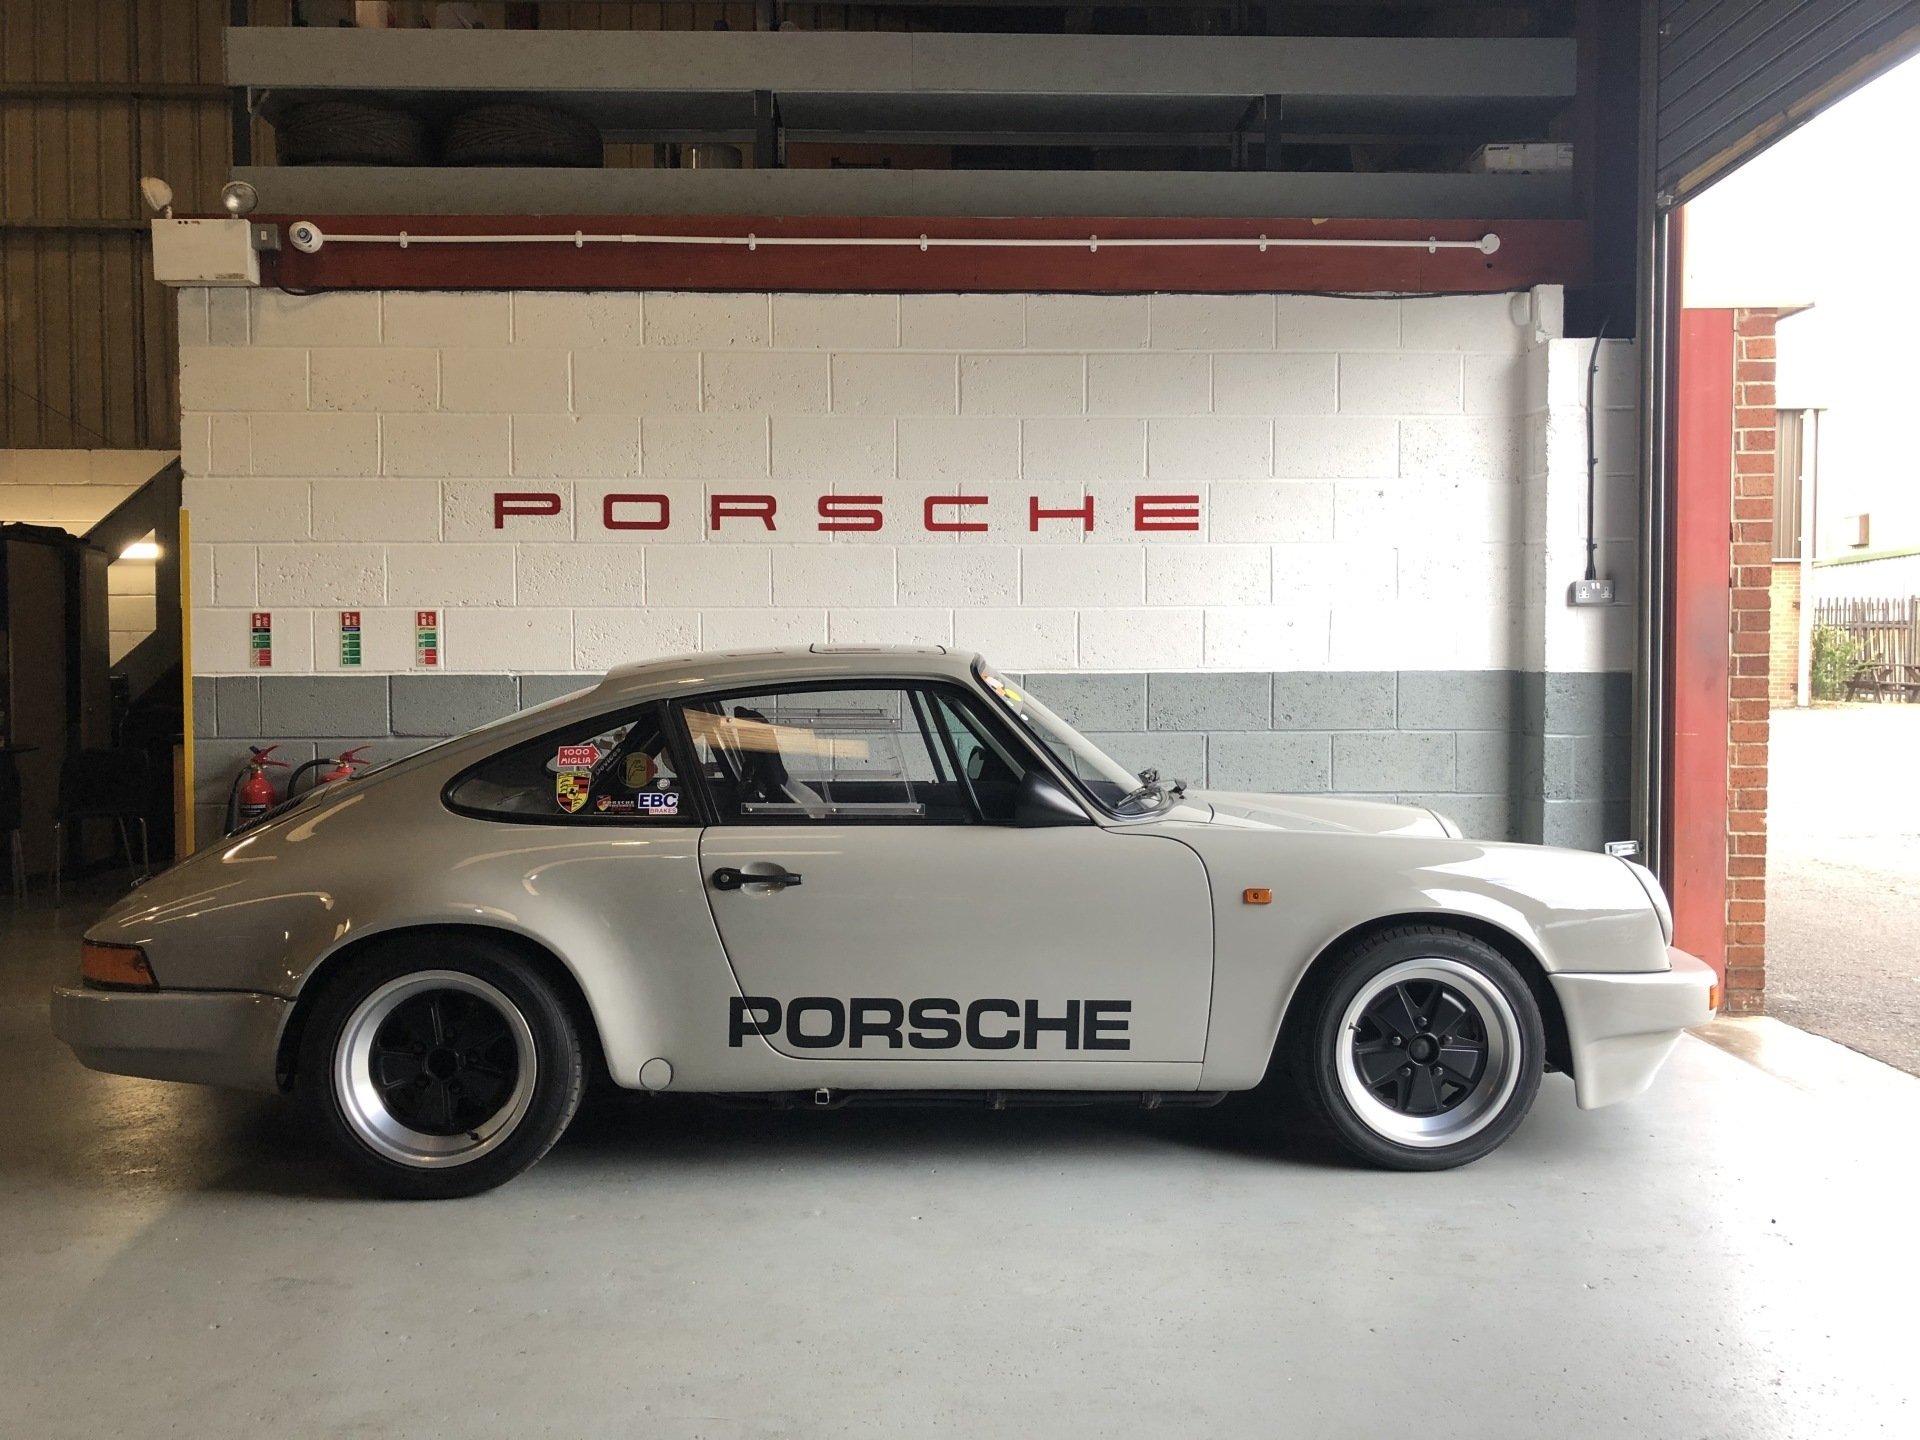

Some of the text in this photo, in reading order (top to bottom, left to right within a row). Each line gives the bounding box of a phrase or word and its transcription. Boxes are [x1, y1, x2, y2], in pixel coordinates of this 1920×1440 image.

[493, 492, 1200, 532] PORSCHE
[563, 748, 590, 756] 1000
[560, 756, 591, 764] MIGLIA
[639, 793, 678, 808] EBC
[728, 996, 1132, 1050] PORSCHE
